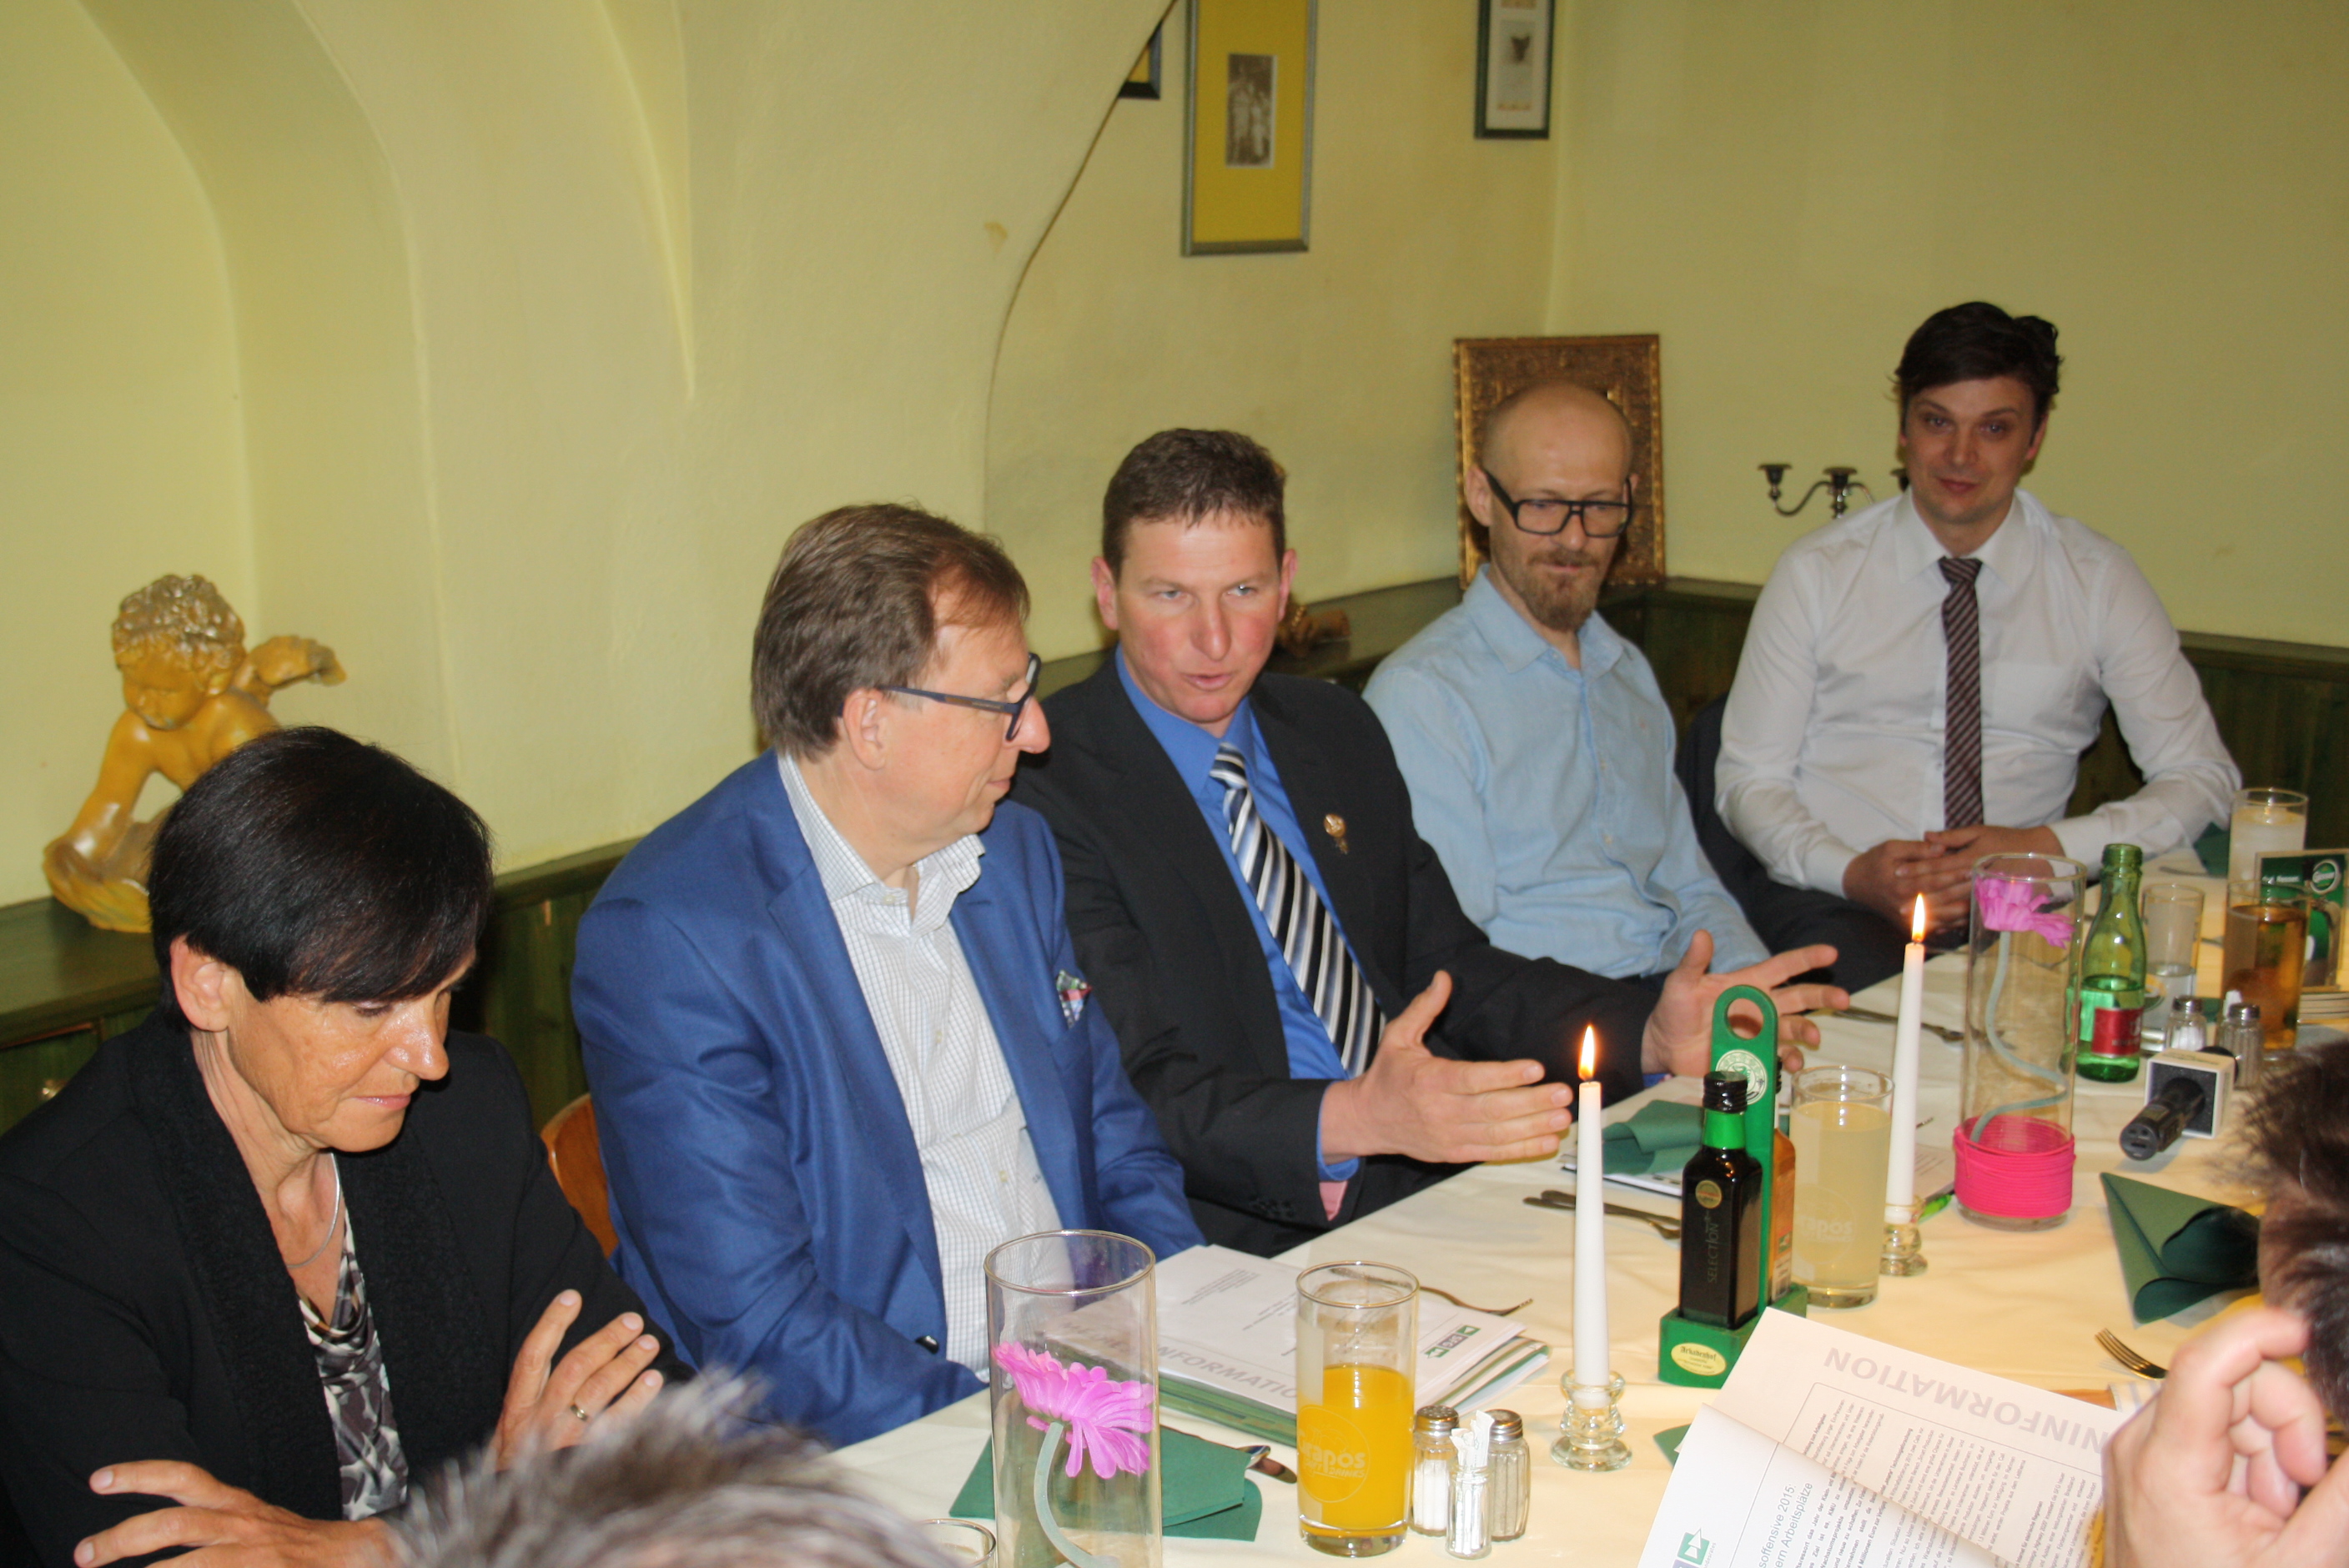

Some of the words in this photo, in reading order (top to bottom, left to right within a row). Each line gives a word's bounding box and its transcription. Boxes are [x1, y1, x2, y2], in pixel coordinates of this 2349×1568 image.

[1705, 1222, 1719, 1283] SELECTION
[1922, 1429, 1934, 1449] Production
[1904, 1452, 1913, 1462] 2015
[1934, 1451, 1948, 1477] Unternehmen
[1909, 1490, 1919, 1504] Zukunft
[1919, 1473, 1927, 1484] damit
[1927, 1453, 1936, 1465] große
[1932, 1438, 1942, 1453] Chance
[1776, 1481, 1797, 1512] 2015:
[1987, 1509, 1995, 1519] Euro
[2005, 1455, 2016, 1473] Rahmen
[2075, 1478, 2086, 1497] entweder
[1778, 1480, 1814, 1548] Arbeitsplätze
[1805, 1528, 1814, 1540] das
[1810, 1512, 1820, 1526] Jahr
[1816, 1502, 1824, 1512] der
[1962, 1500, 1974, 1520] Produktion
[1811, 1545, 1820, 1557] Ziel
[1827, 1502, 1836, 1515] KMU
[1858, 1519, 1867, 1532] stellt
[1889, 1525, 1902, 1545] Situation
[2065, 1545, 2074, 1556] oder
[2082, 1499, 2090, 1510] ihren
[1838, 1540, 1847, 1555] neue
[1858, 1538, 1873, 1565] Millionen
[1867, 1525, 1877, 1539] Euro
[1899, 1545, 1907, 1555] Nur
[2041, 1542, 2051, 1558] Ausbau
